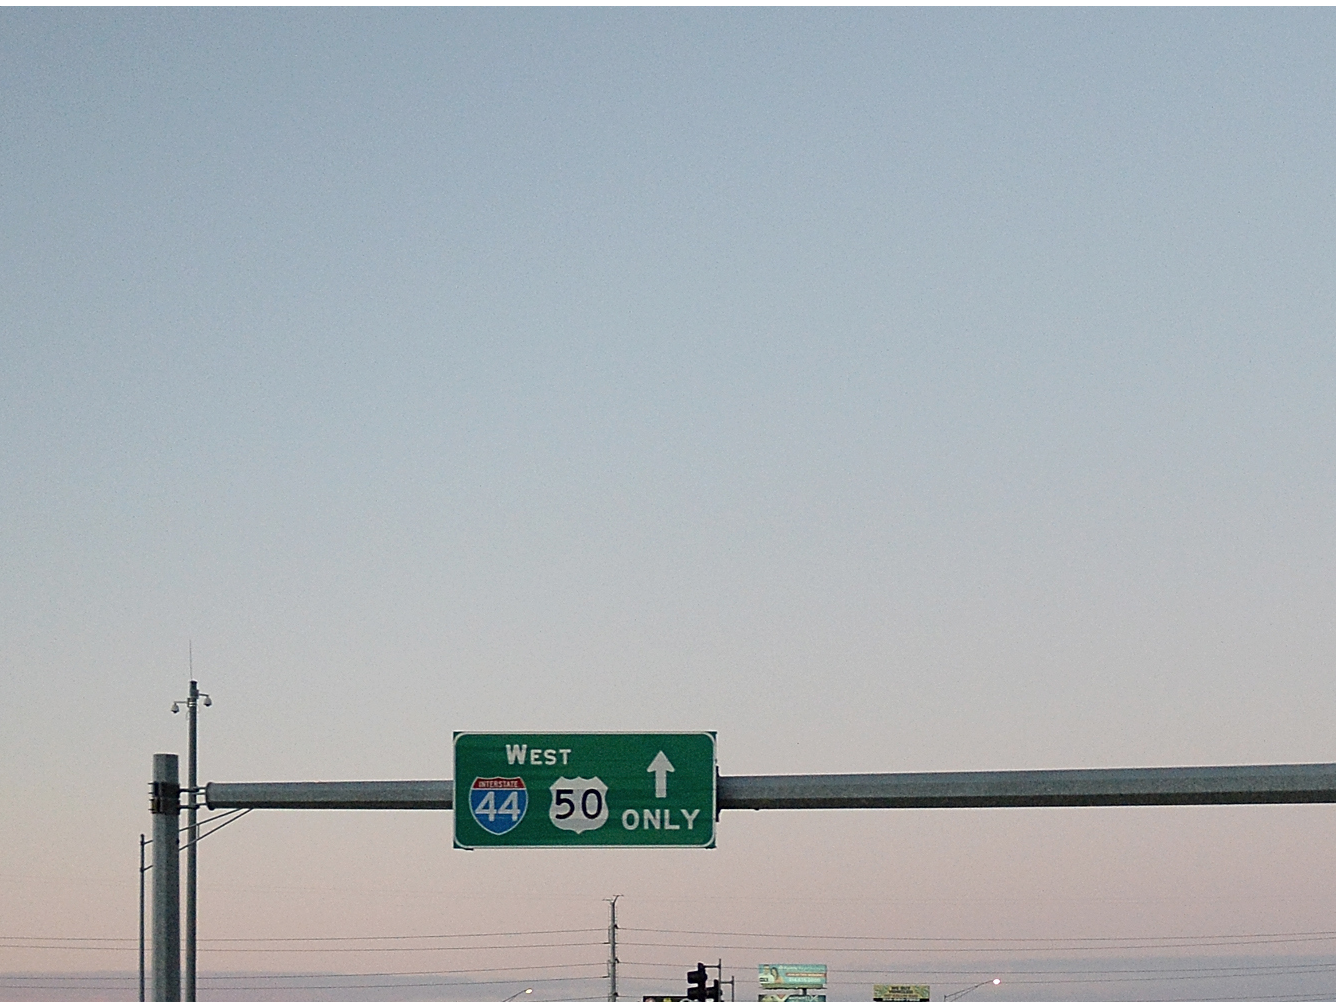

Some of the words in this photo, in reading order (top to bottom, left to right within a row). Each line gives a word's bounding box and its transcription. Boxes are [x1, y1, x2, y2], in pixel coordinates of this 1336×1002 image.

[478, 780, 519, 788] INTERSTATE
[475, 791, 521, 822] 44
[555, 788, 602, 820] 50
[621, 808, 700, 830] ONLY
